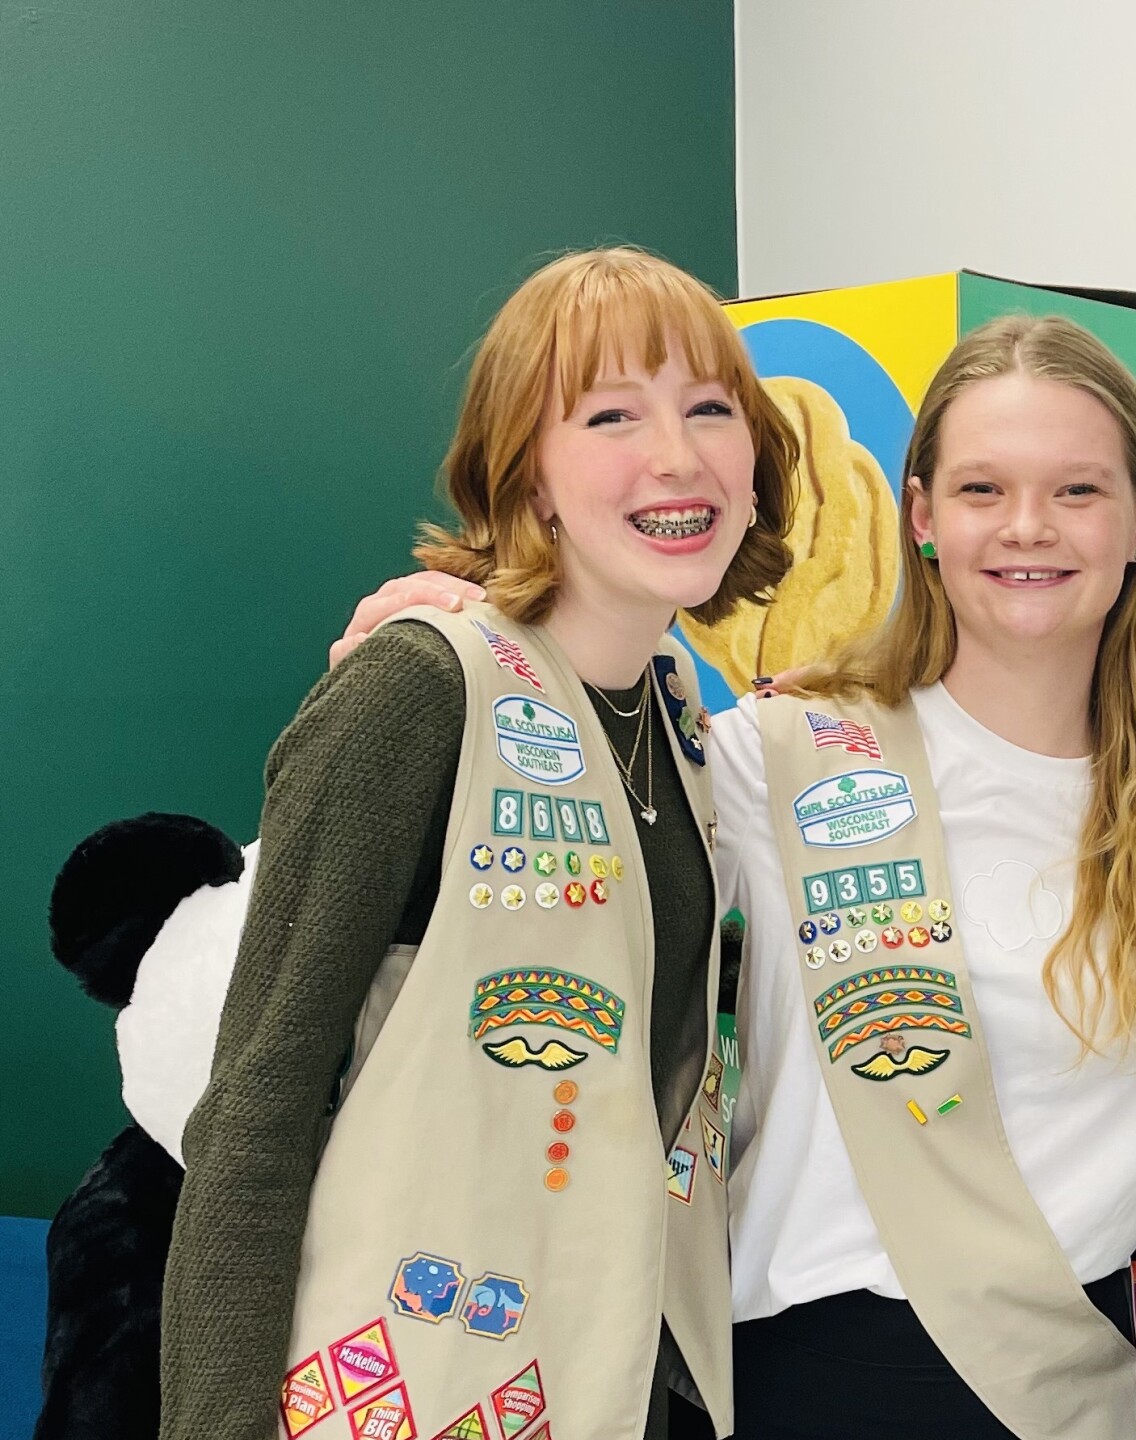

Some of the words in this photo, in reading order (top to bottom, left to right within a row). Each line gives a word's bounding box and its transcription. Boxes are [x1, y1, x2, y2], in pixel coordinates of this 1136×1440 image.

[515, 719, 553, 736] SCOUTS
[553, 726, 575, 739] USA
[515, 743, 561, 761] WISCONSIN
[517, 755, 563, 774] SOUTHEAST
[800, 802, 826, 817] GIRL
[828, 789, 878, 809] SCOUTS
[879, 783, 904, 796] USA
[498, 796, 604, 839] 8698
[826, 809, 887, 831] WISCONSIN
[828, 818, 891, 842] SOUTHEAST
[810, 865, 917, 906] 9355
[339, 1347, 386, 1377] Marketing
[289, 1381, 324, 1404] Business
[501, 1388, 541, 1407] Comparison
[288, 1394, 316, 1417] Plan
[371, 1407, 402, 1423] Think
[502, 1398, 536, 1417] Shopping
